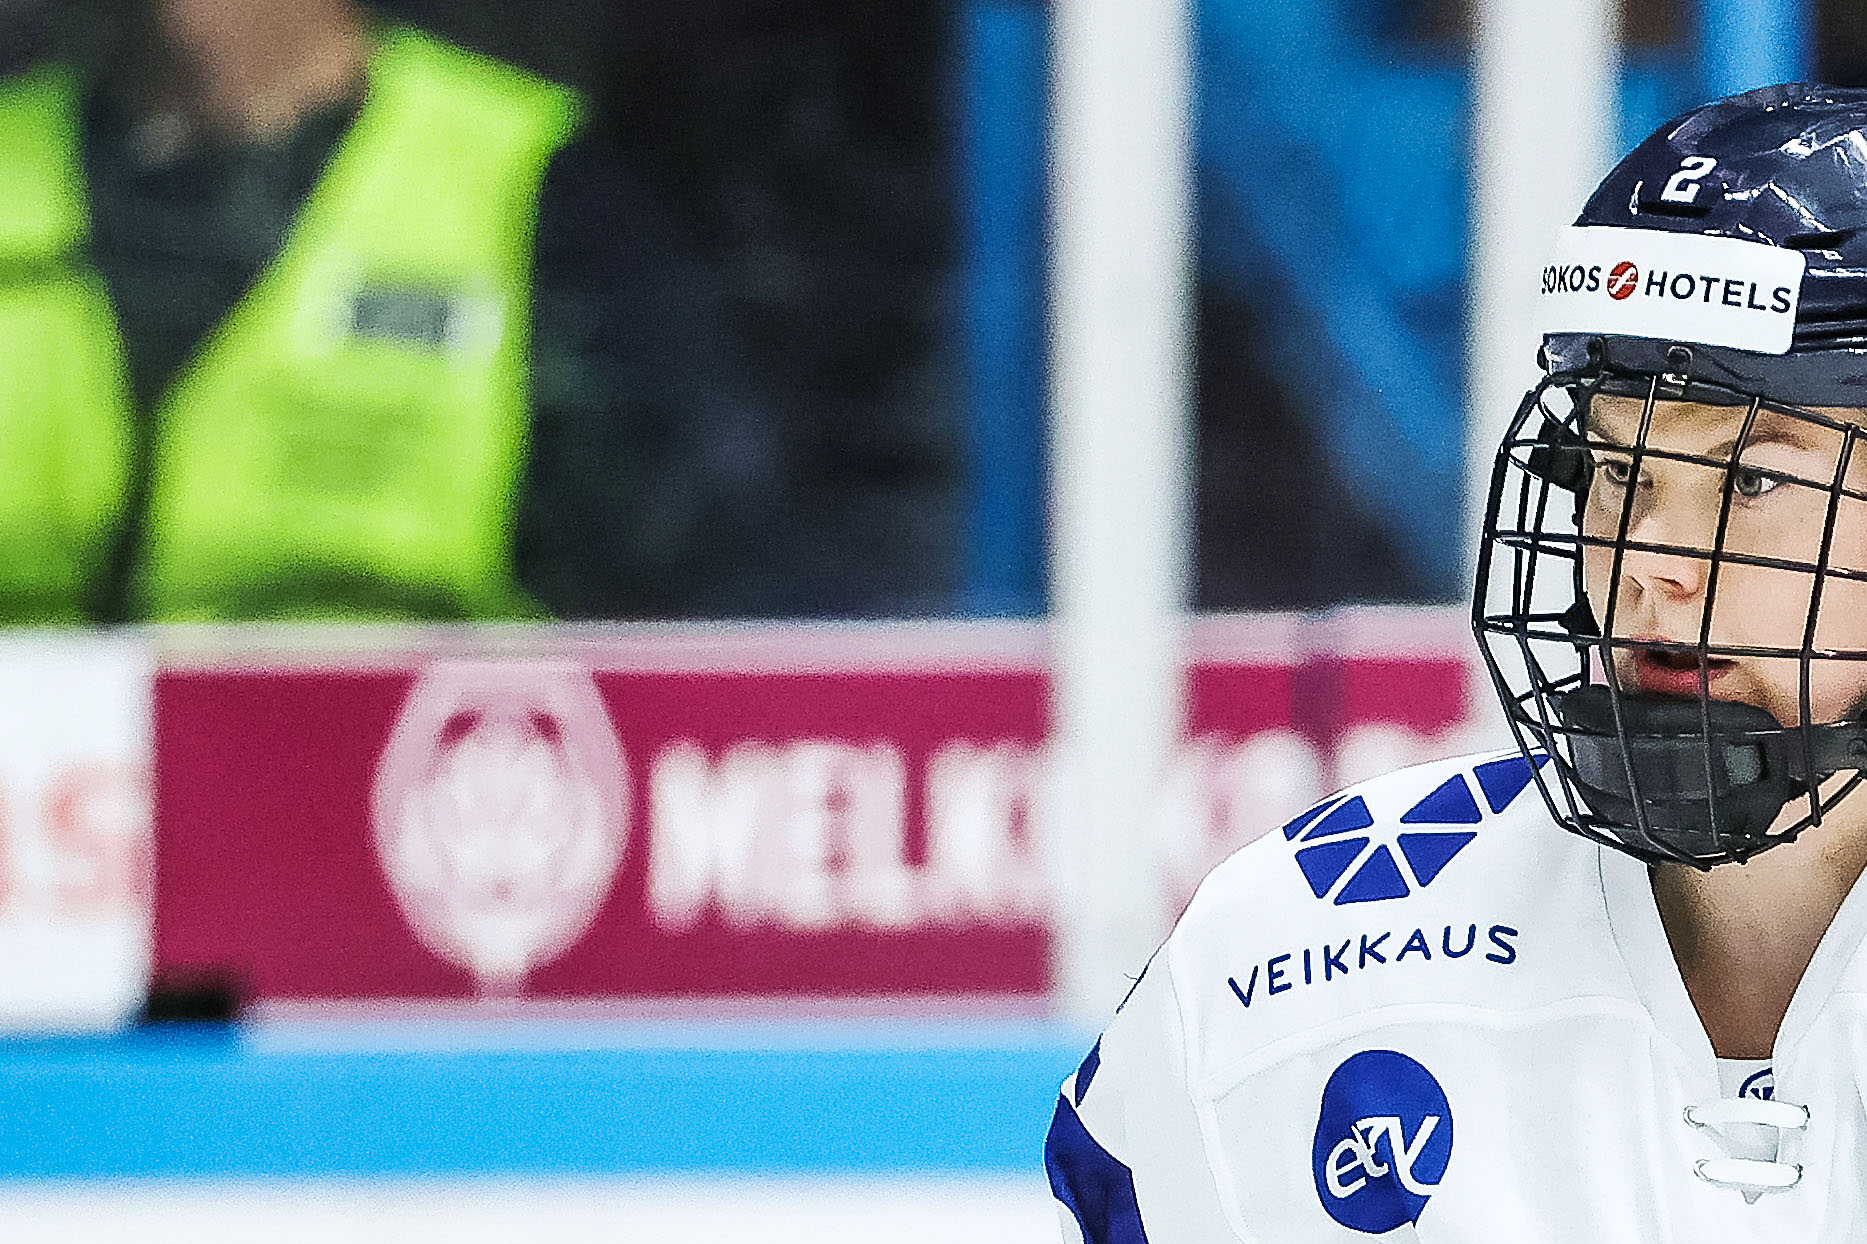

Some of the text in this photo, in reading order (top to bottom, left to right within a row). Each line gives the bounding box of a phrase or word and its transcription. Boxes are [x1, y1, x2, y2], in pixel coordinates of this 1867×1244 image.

[1660, 155, 1718, 204] 2
[1644, 269, 1792, 314] HOTELS
[1227, 923, 1519, 1008] VEIKKAUS
